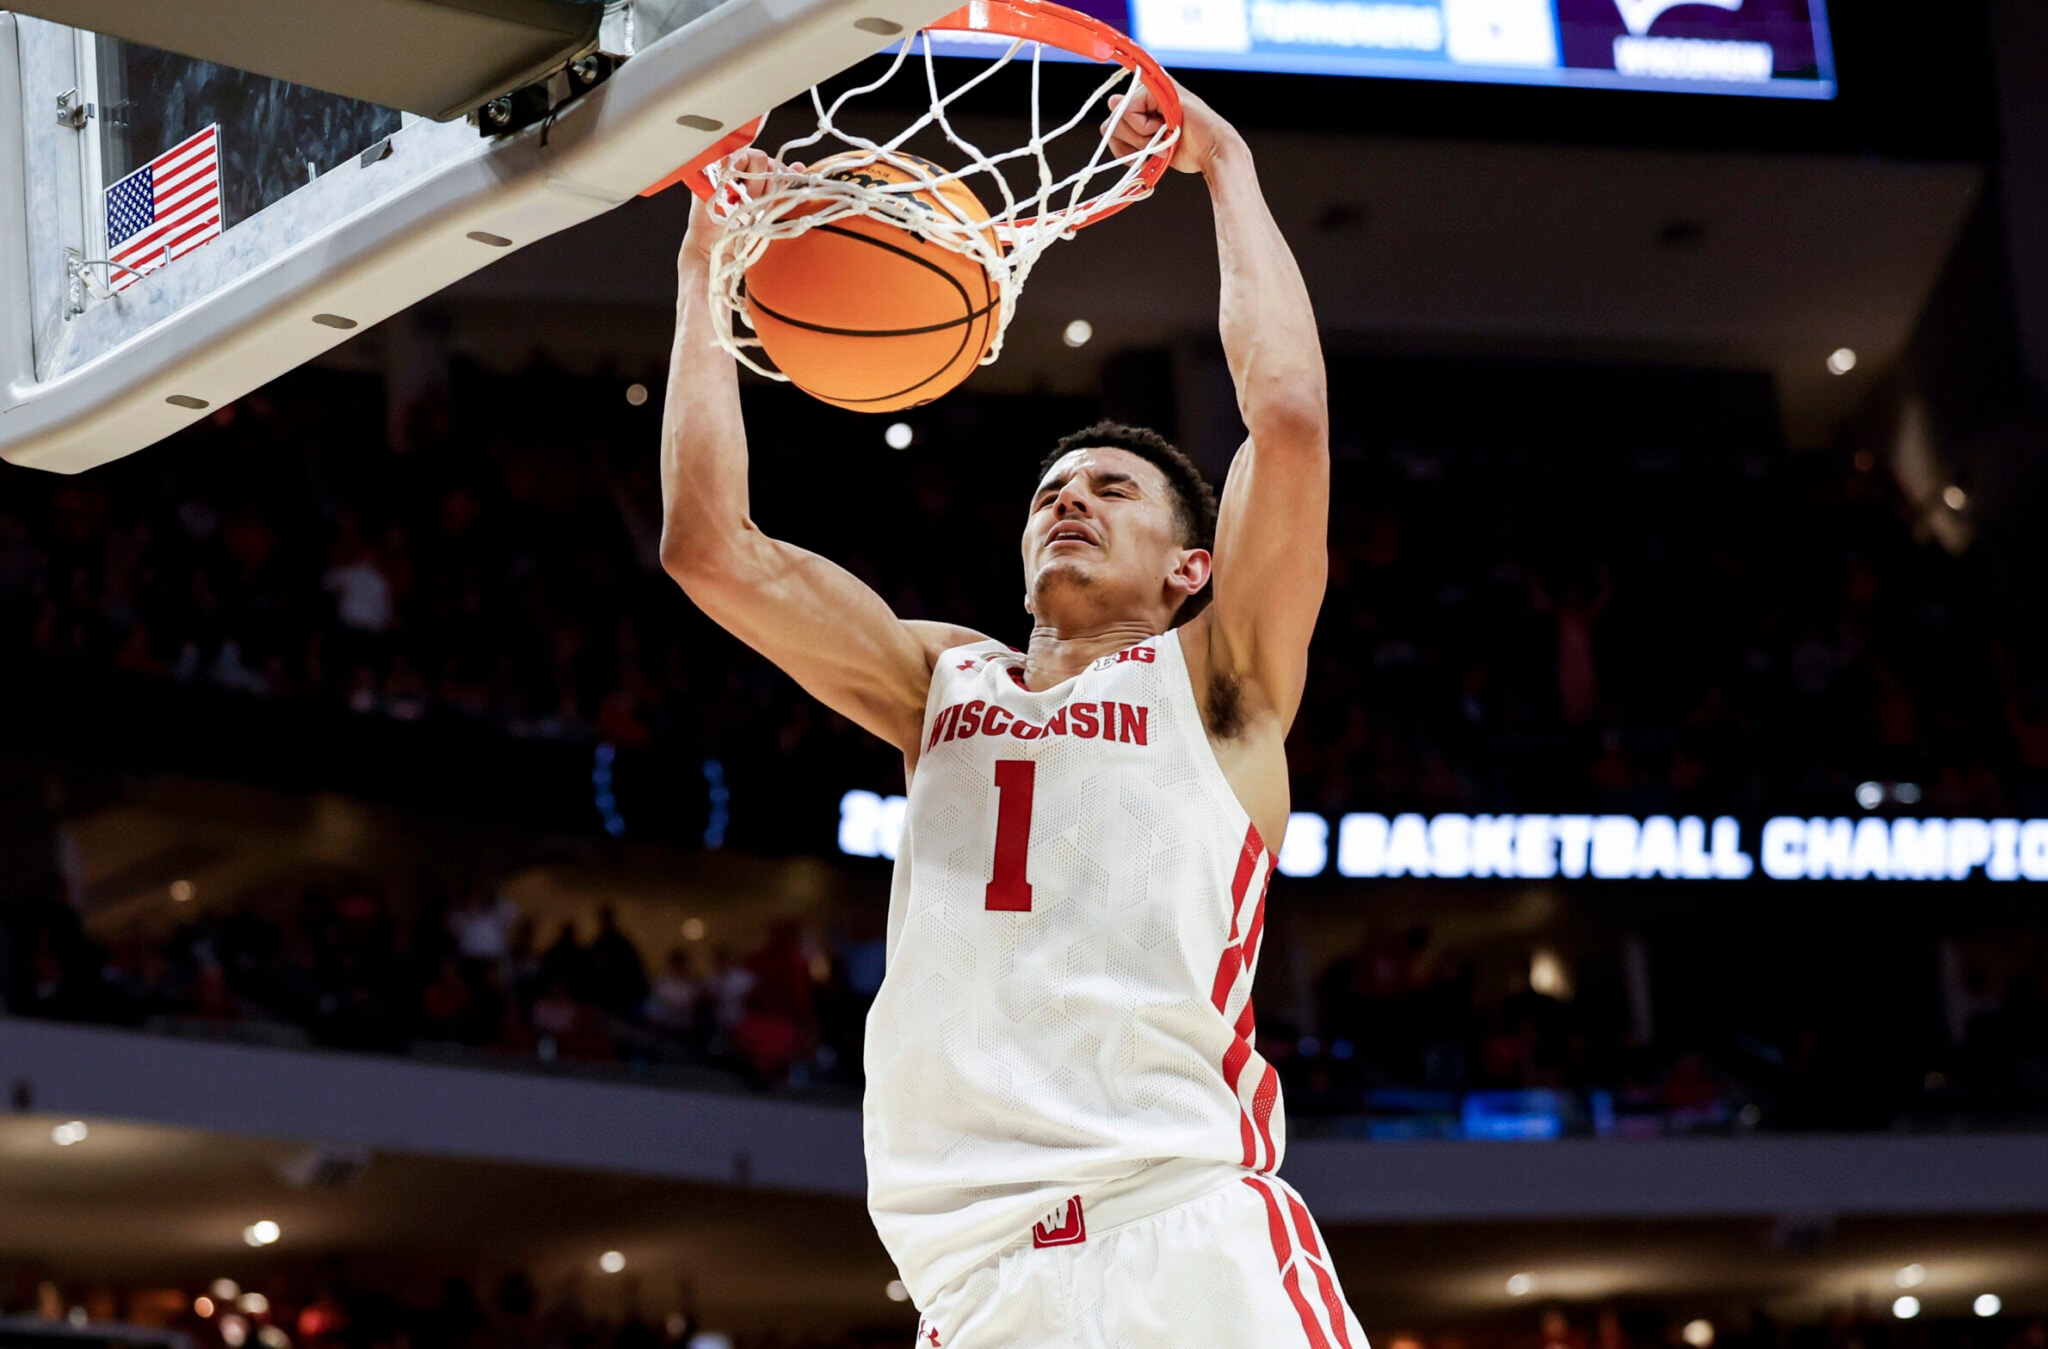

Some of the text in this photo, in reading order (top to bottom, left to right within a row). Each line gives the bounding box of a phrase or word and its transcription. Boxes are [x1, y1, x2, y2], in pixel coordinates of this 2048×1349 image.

[926, 699, 1149, 754] WISCONSIN
[984, 759, 1036, 912] 1
[1337, 812, 1755, 879] BASKETBALL
[1762, 815, 2048, 882] CHAMPIO
